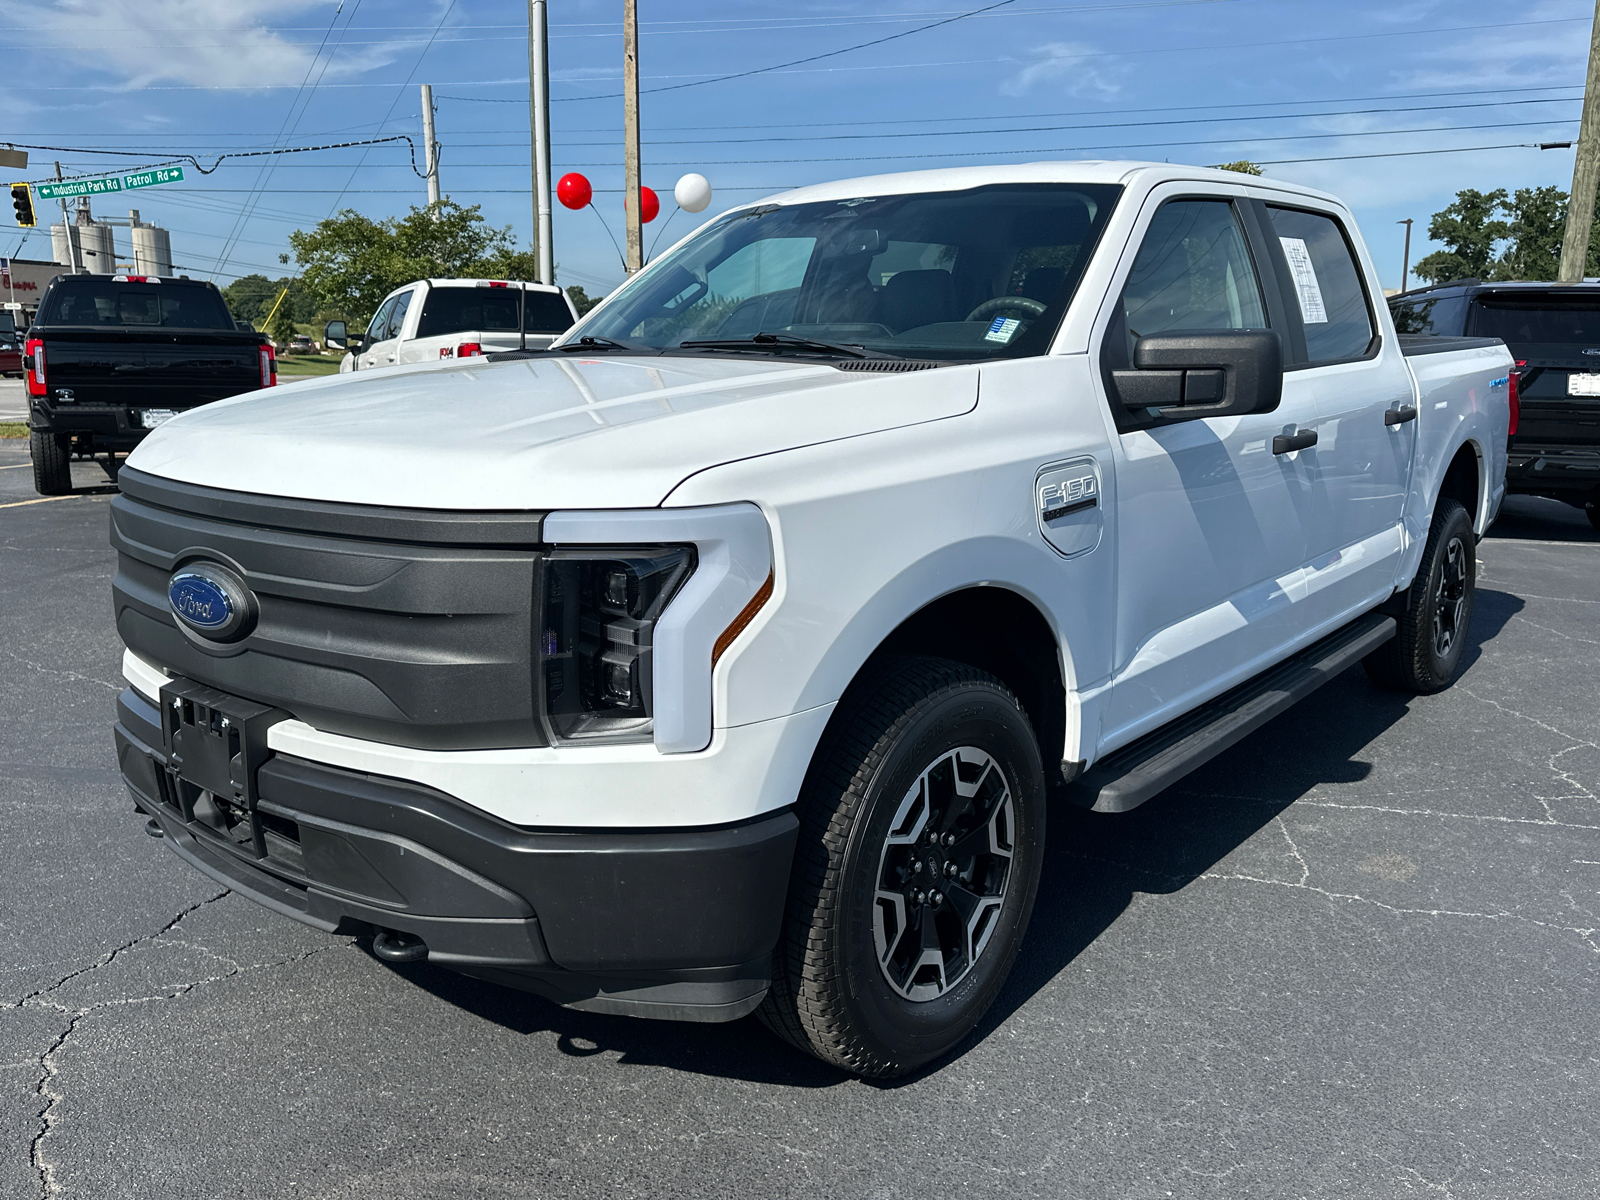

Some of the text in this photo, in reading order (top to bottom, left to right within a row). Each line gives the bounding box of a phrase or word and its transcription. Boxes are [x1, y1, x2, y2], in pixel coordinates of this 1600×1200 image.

[51, 179, 118, 196] Industrial Park Rd
[127, 171, 169, 187] Patrol Rd
[1040, 475, 1096, 510] F-150
[178, 585, 214, 619] Ford
